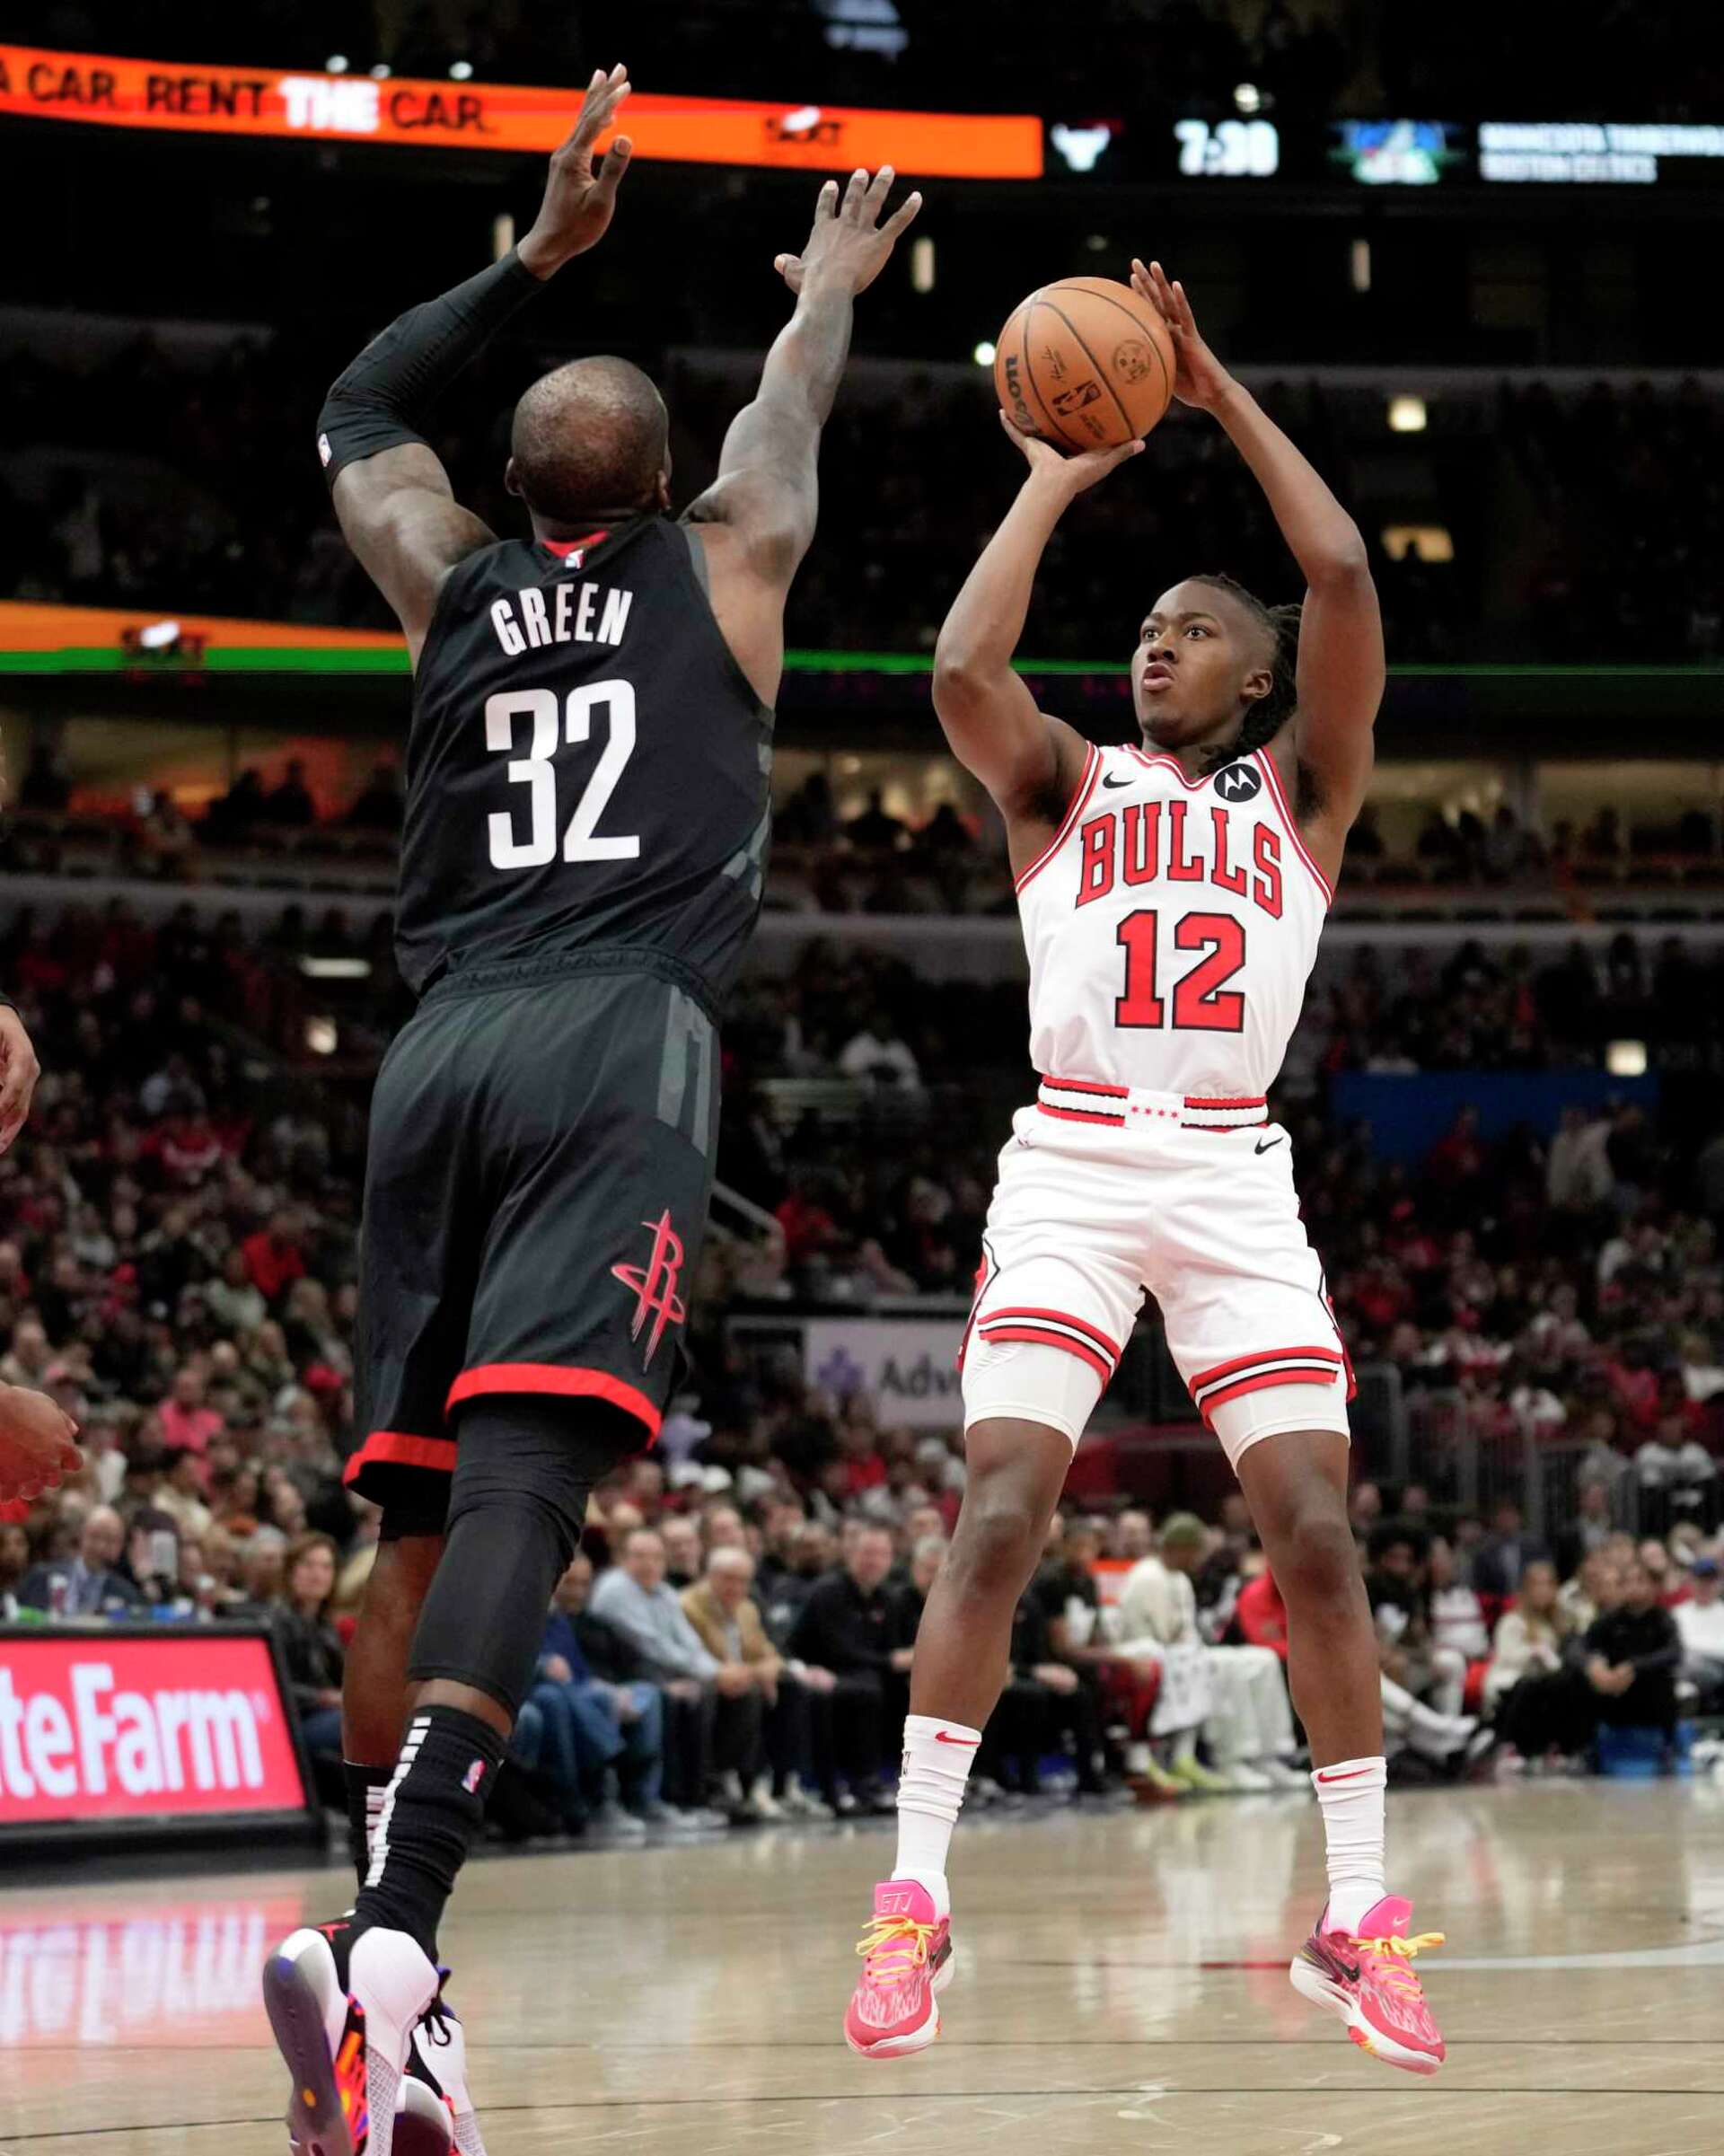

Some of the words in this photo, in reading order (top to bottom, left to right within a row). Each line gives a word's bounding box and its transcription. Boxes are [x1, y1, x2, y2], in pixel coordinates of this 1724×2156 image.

[146, 75, 267, 118] RENT
[280, 76, 380, 133] THE
[489, 582, 633, 656] GREEN
[485, 679, 641, 870] 32
[1076, 800, 1283, 920] BULLS
[1114, 909, 1246, 1034] 12
